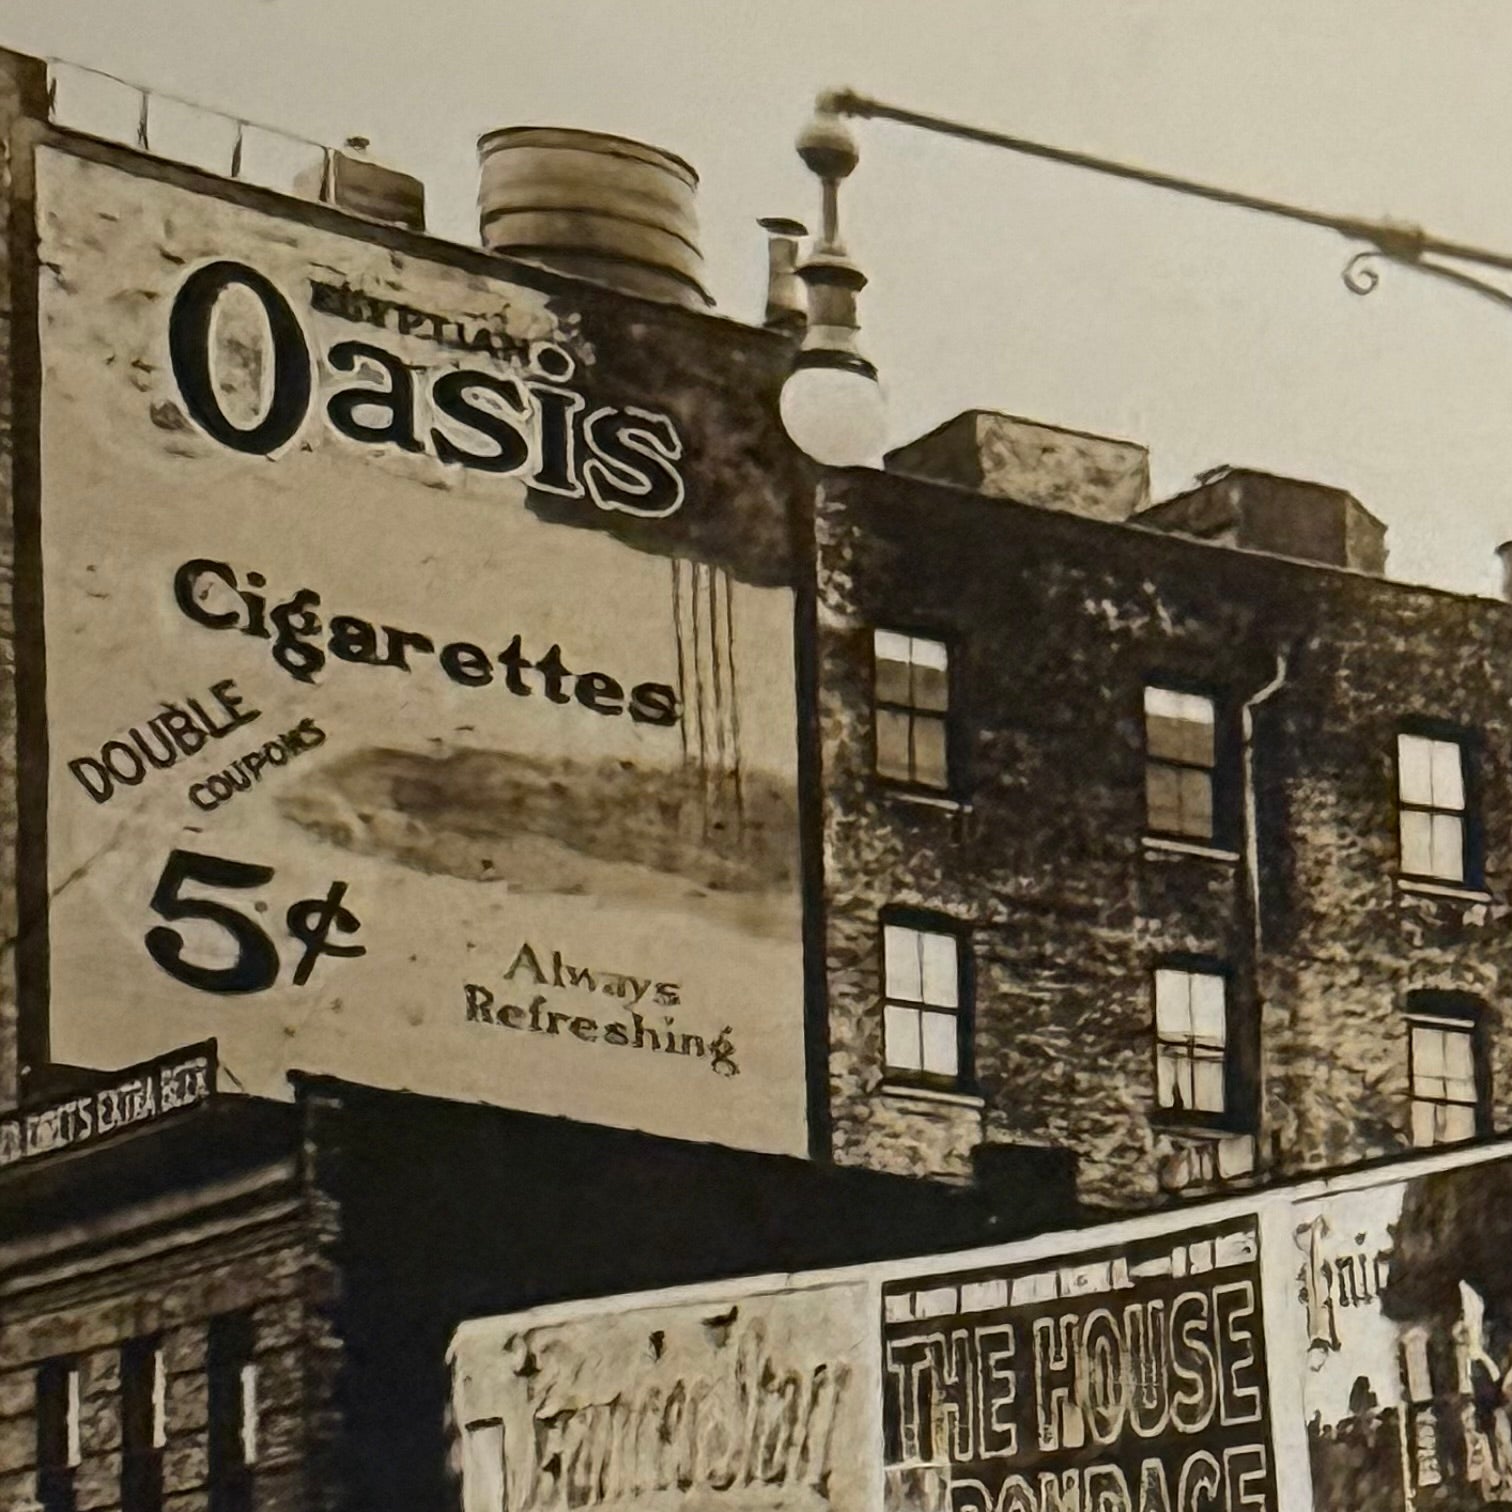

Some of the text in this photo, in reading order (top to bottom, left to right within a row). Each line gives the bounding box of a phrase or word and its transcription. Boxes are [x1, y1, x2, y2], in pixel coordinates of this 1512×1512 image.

[168, 260, 684, 518] Oasis
[174, 558, 681, 728] Cigarettes
[68, 679, 262, 803] DOUBLE
[188, 718, 327, 812] COUPONS
[464, 984, 741, 1078] Refreshing
[503, 943, 681, 1012] Always
[890, 1324, 1017, 1466] THE
[1033, 1281, 1262, 1451] HOUSE
